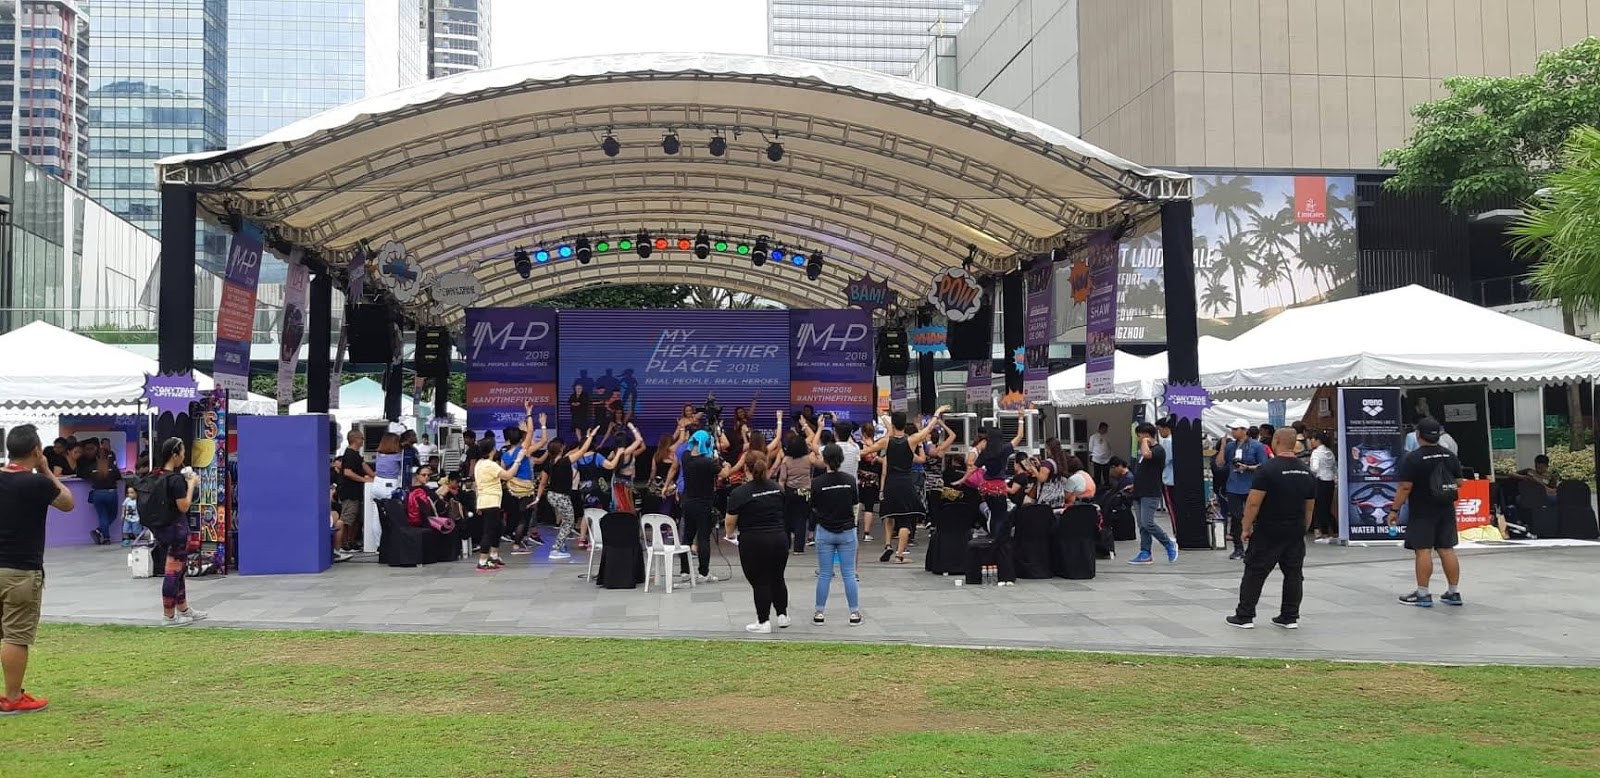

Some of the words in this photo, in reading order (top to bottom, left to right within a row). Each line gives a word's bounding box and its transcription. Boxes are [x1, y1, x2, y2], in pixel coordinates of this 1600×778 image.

[850, 284, 886, 304] BAM!
[940, 275, 980, 311] POW
[1090, 303, 1110, 318] SHAW
[662, 329, 696, 342] MY
[525, 351, 550, 360] 2018
[654, 344, 779, 358] HEALTHIER
[844, 352, 868, 360] 2018
[645, 360, 722, 373] PLACE
[726, 363, 760, 373] 2018
[812, 386, 852, 394] #MHP2018
[1351, 526, 1375, 534] WATER
[1377, 525, 1408, 534] INSNC
